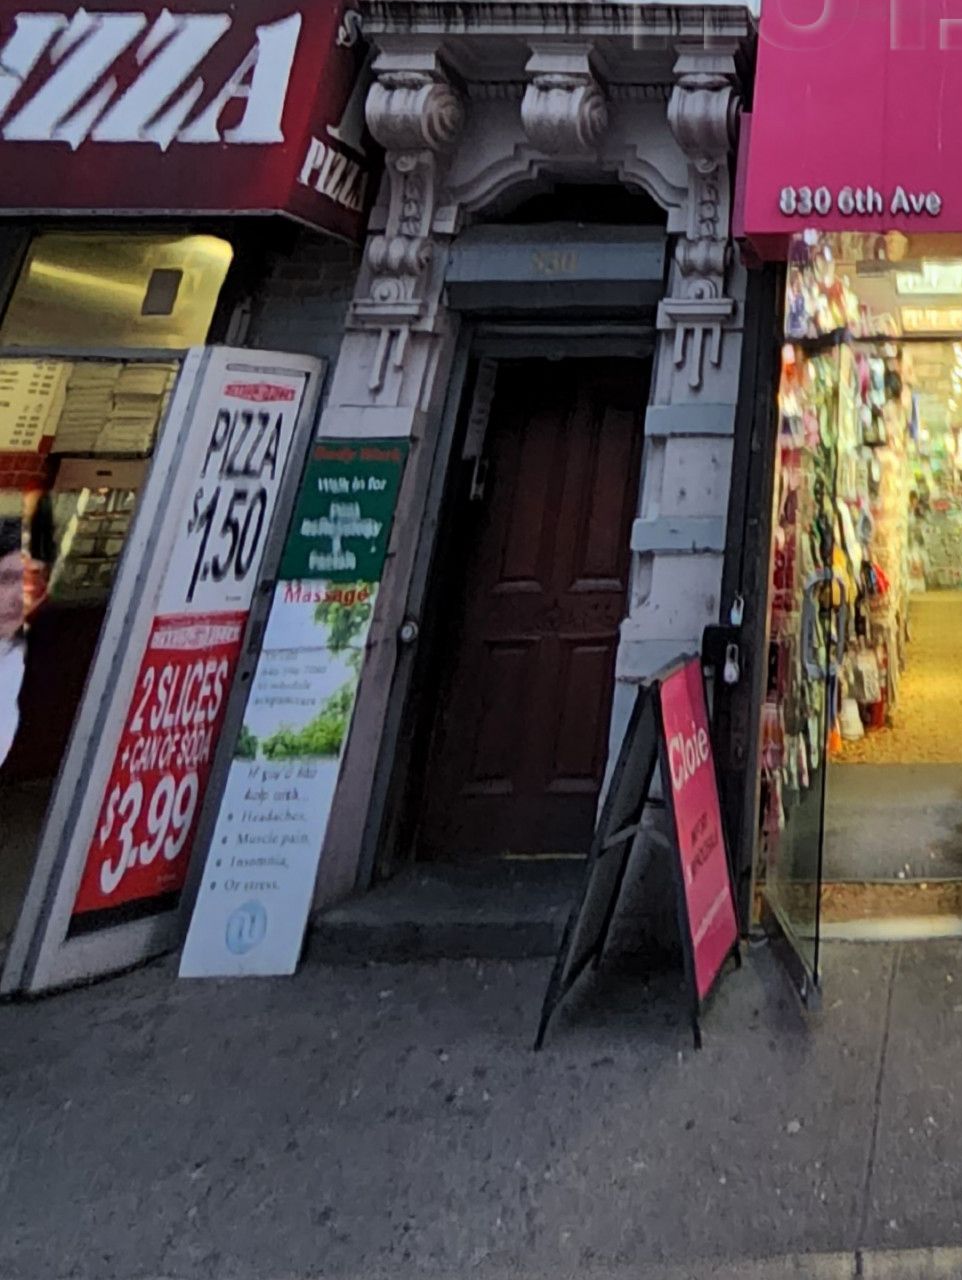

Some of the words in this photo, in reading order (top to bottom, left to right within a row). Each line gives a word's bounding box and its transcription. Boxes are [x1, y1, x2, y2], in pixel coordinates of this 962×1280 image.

[779, 184, 832, 216] 830
[837, 184, 883, 215] 6th
[890, 185, 943, 217] Ave
[200, 408, 284, 481] PIZZA
[185, 485, 268, 604] $1.50
[284, 582, 370, 607] Massage
[130, 665, 155, 732] 2
[149, 654, 230, 730] SLICES
[130, 731, 160, 775] CAN
[668, 721, 709, 791] Cloie
[100, 772, 199, 895] $3.99
